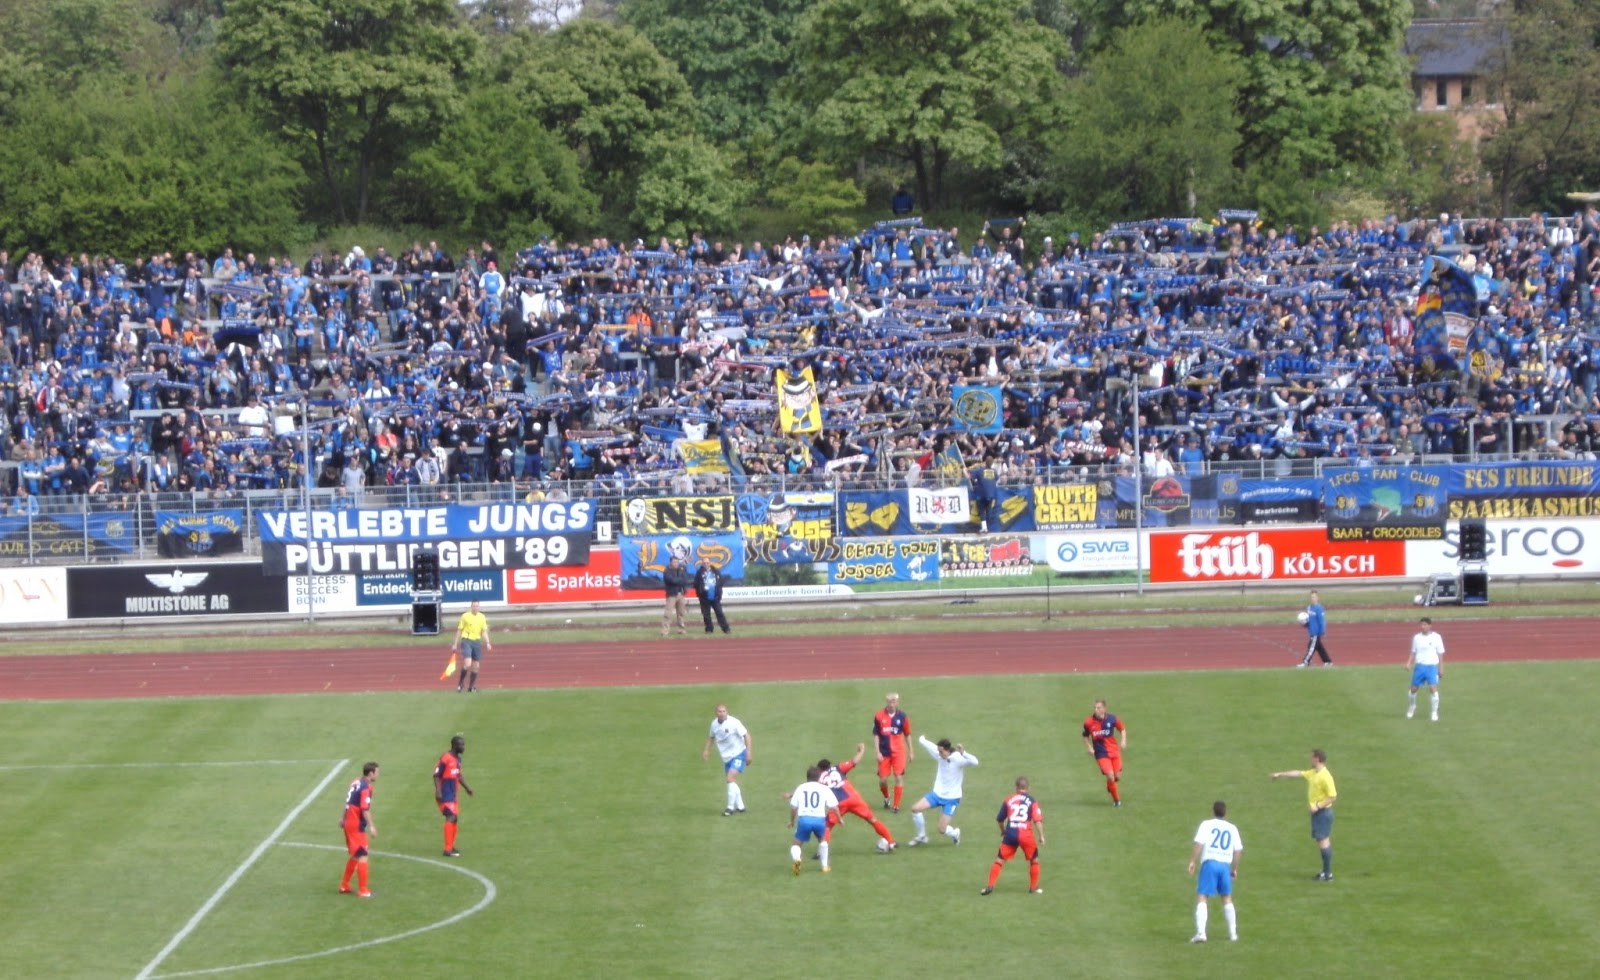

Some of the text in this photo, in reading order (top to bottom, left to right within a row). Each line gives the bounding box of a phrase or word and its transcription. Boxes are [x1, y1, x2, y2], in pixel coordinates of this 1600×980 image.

[1372, 469, 1397, 480] FAN
[1410, 470, 1440, 486] CLUB
[1464, 466, 1594, 489] FCS FREUNDE
[1034, 485, 1097, 504] YOUTH
[262, 502, 589, 539] VERLEBTE JUNGS
[1035, 503, 1096, 523] CREW
[1333, 528, 1362, 539] SAAR
[1373, 527, 1441, 538] CROCODILES
[50, 539, 96, 554] CATS
[1082, 541, 1130, 553] SWB
[1283, 553, 1375, 574] KÖLSCH
[363, 579, 492, 595] Entdeck Vielfalt!
[547, 573, 621, 592] Sparkass
[126, 595, 229, 612] MULTISTONE AG
[803, 791, 820, 808] 10
[1010, 804, 1029, 822] 23
[1210, 828, 1231, 850] 20
